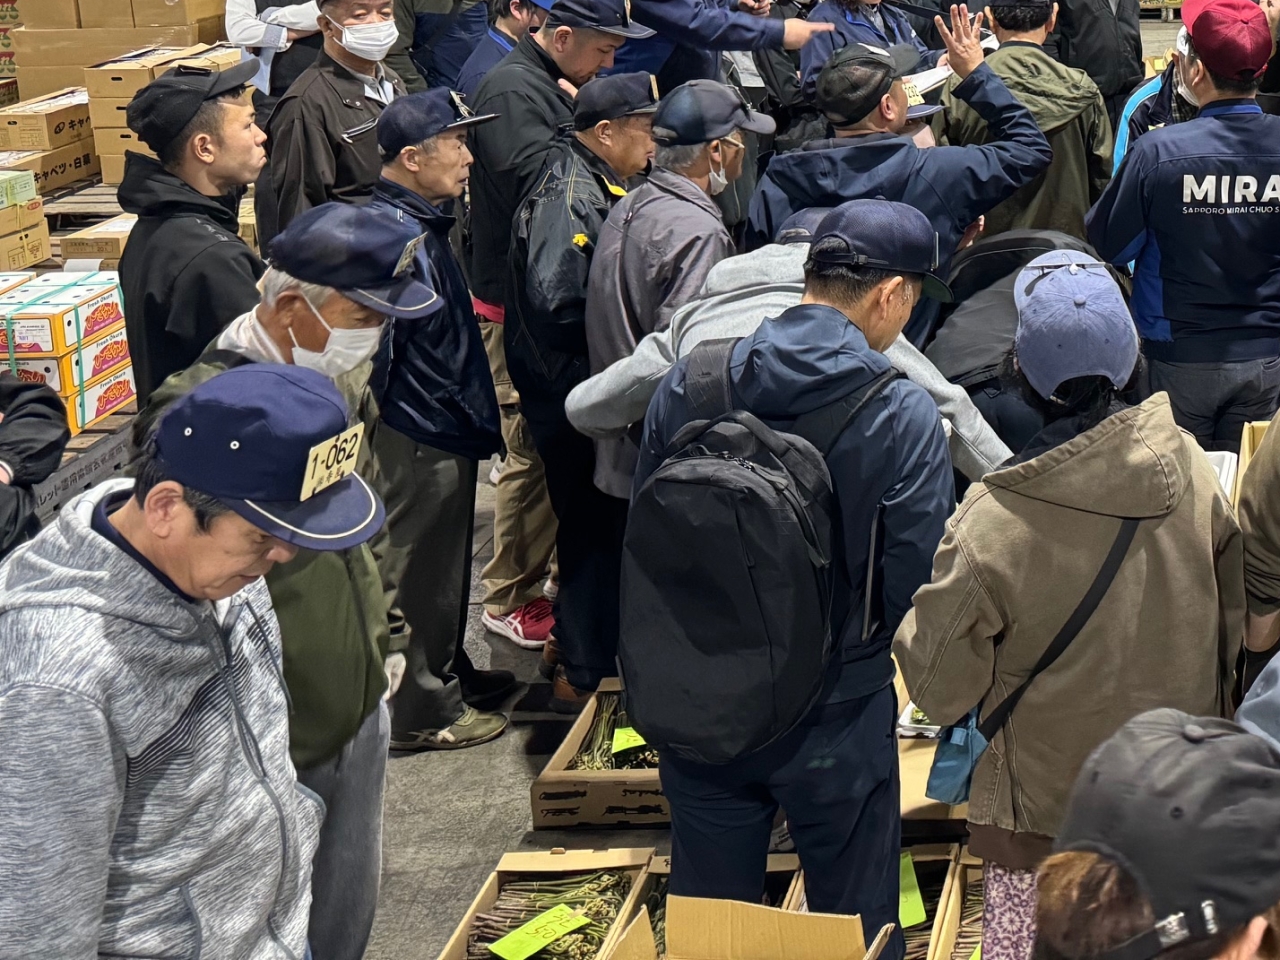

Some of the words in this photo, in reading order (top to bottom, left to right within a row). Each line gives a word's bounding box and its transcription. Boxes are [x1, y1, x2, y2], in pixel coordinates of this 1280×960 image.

[33, 153, 92, 183] キャベツ・白菜
[1182, 206, 1225, 215] SAPPORO
[1226, 206, 1248, 215] MIRAI
[1249, 206, 1273, 214] CHUO
[87, 298, 100, 309] Fresh
[96, 337, 109, 348] Fresh
[99, 378, 113, 389] Fresh
[311, 432, 358, 480] 1-062
